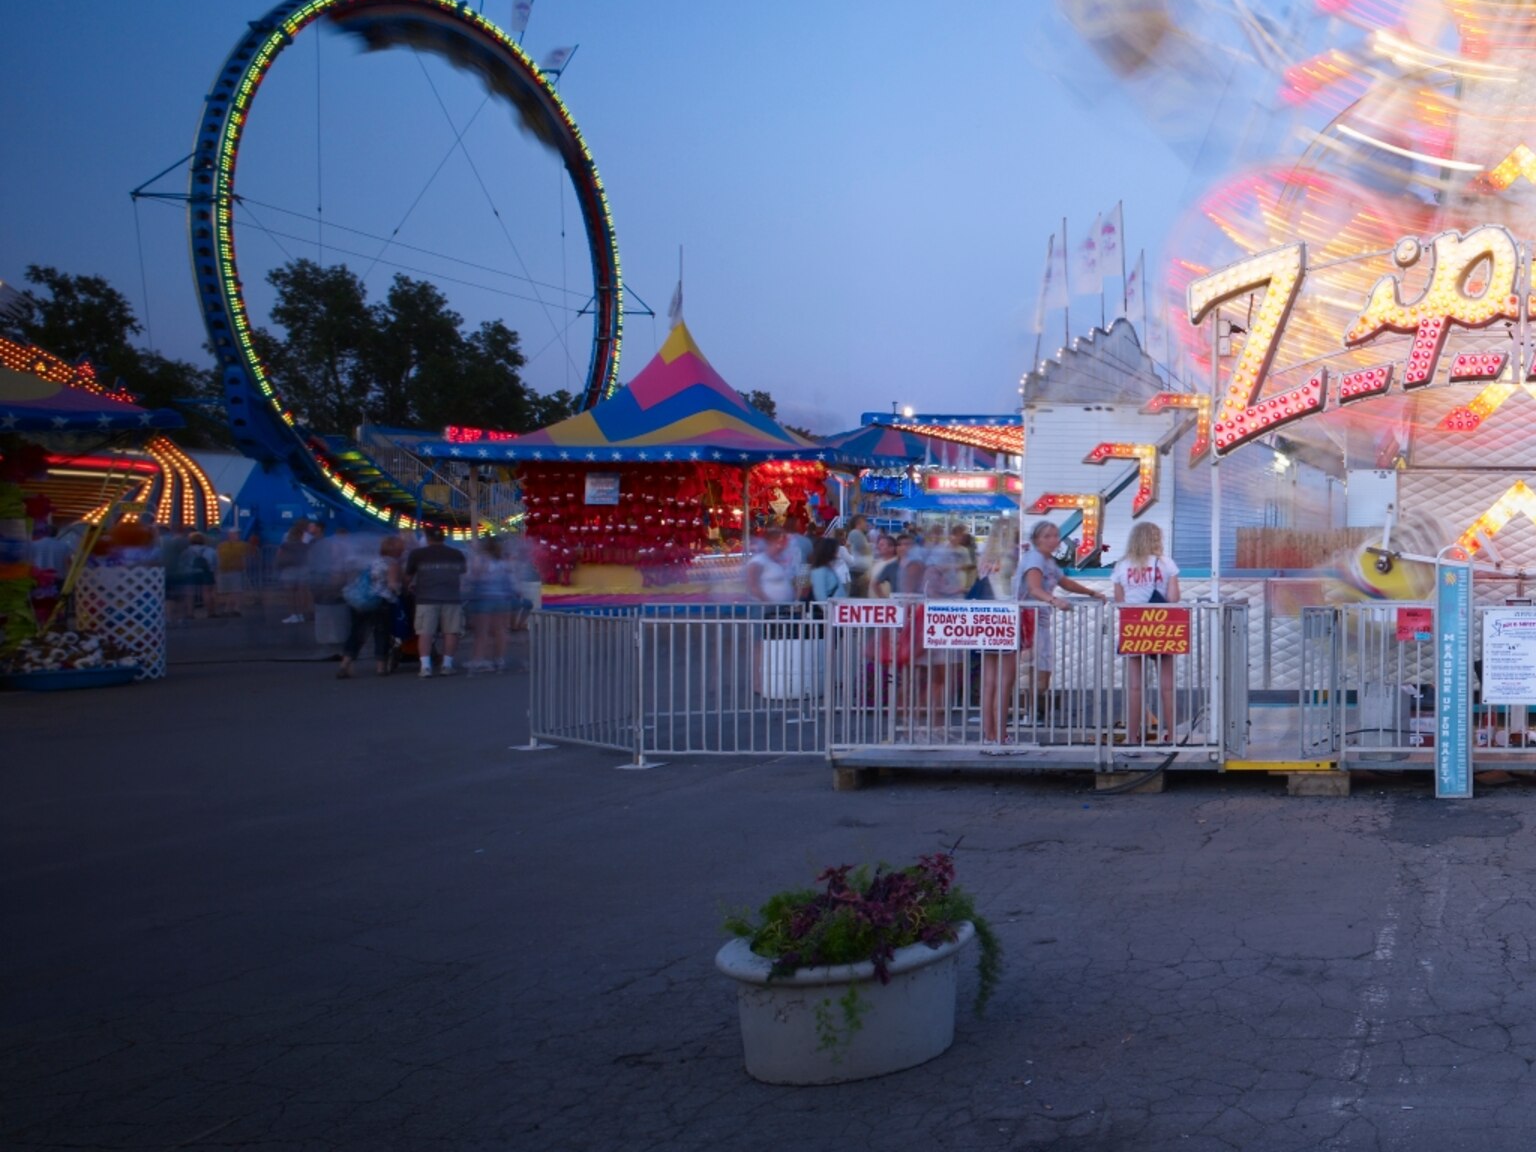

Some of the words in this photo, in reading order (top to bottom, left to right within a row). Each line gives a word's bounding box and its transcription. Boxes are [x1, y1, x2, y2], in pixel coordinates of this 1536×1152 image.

[838, 605, 897, 623] ENTER
[927, 613, 967, 625] TODAY'S
[972, 613, 1017, 625] SPECIAL!
[1140, 608, 1168, 623] NO
[926, 625, 936, 637] 4
[943, 625, 1016, 638] COUPONS
[1122, 623, 1187, 638] SINGLE
[988, 637, 1015, 646] COUPONS
[1121, 639, 1188, 653] RIDERS
